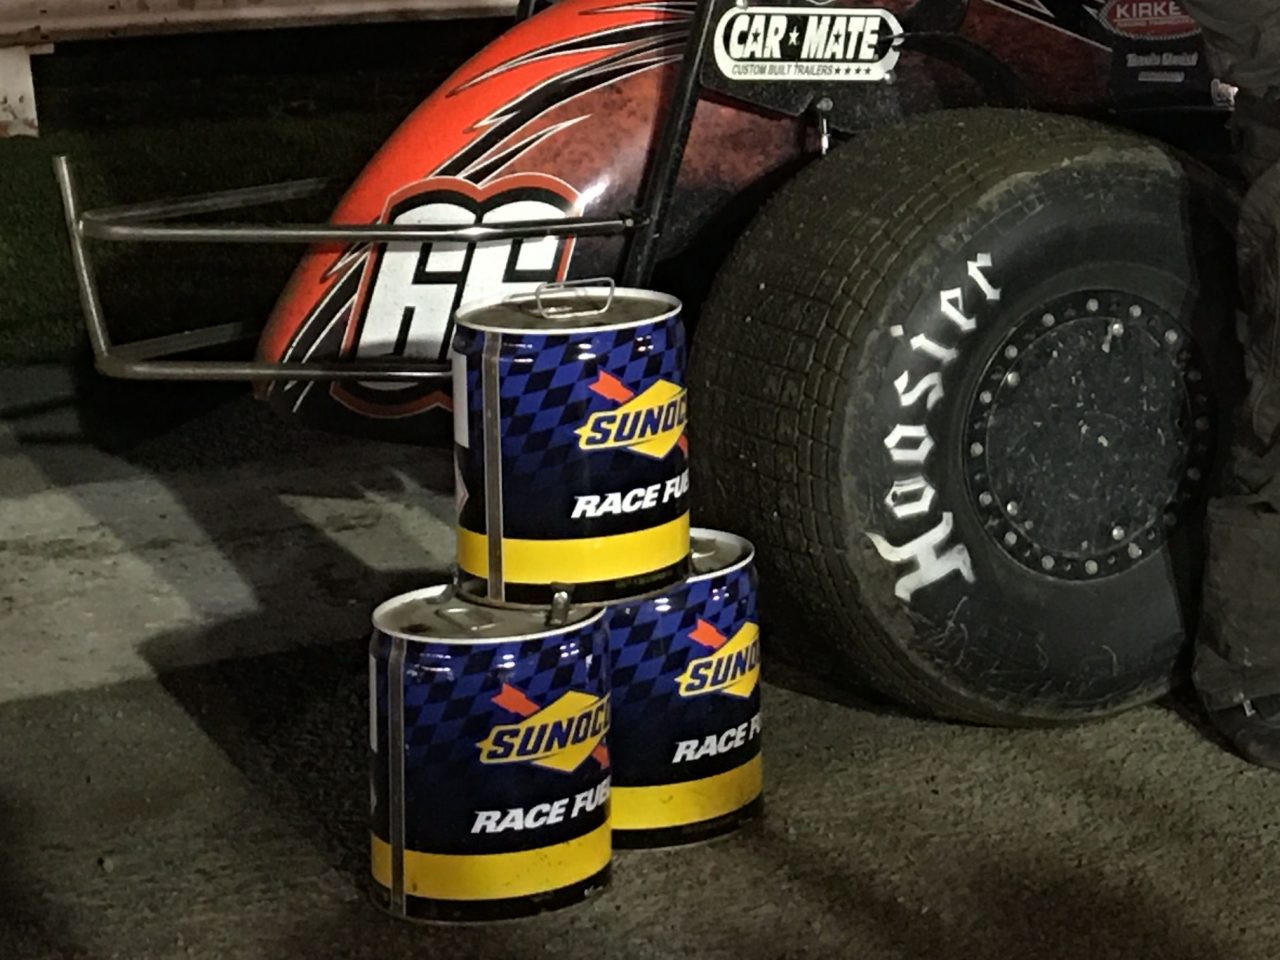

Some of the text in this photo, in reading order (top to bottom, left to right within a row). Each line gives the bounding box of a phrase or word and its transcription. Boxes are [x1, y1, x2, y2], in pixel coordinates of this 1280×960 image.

[1116, 1, 1181, 19] KIRKE
[729, 13, 881, 60] CAR MATE
[732, 64, 835, 76] CUSTOM BUILT TRAILERS
[570, 483, 661, 519] RACE
[486, 701, 611, 759] SUNOC
[672, 722, 748, 763] RACE
[470, 797, 569, 834] RACE
